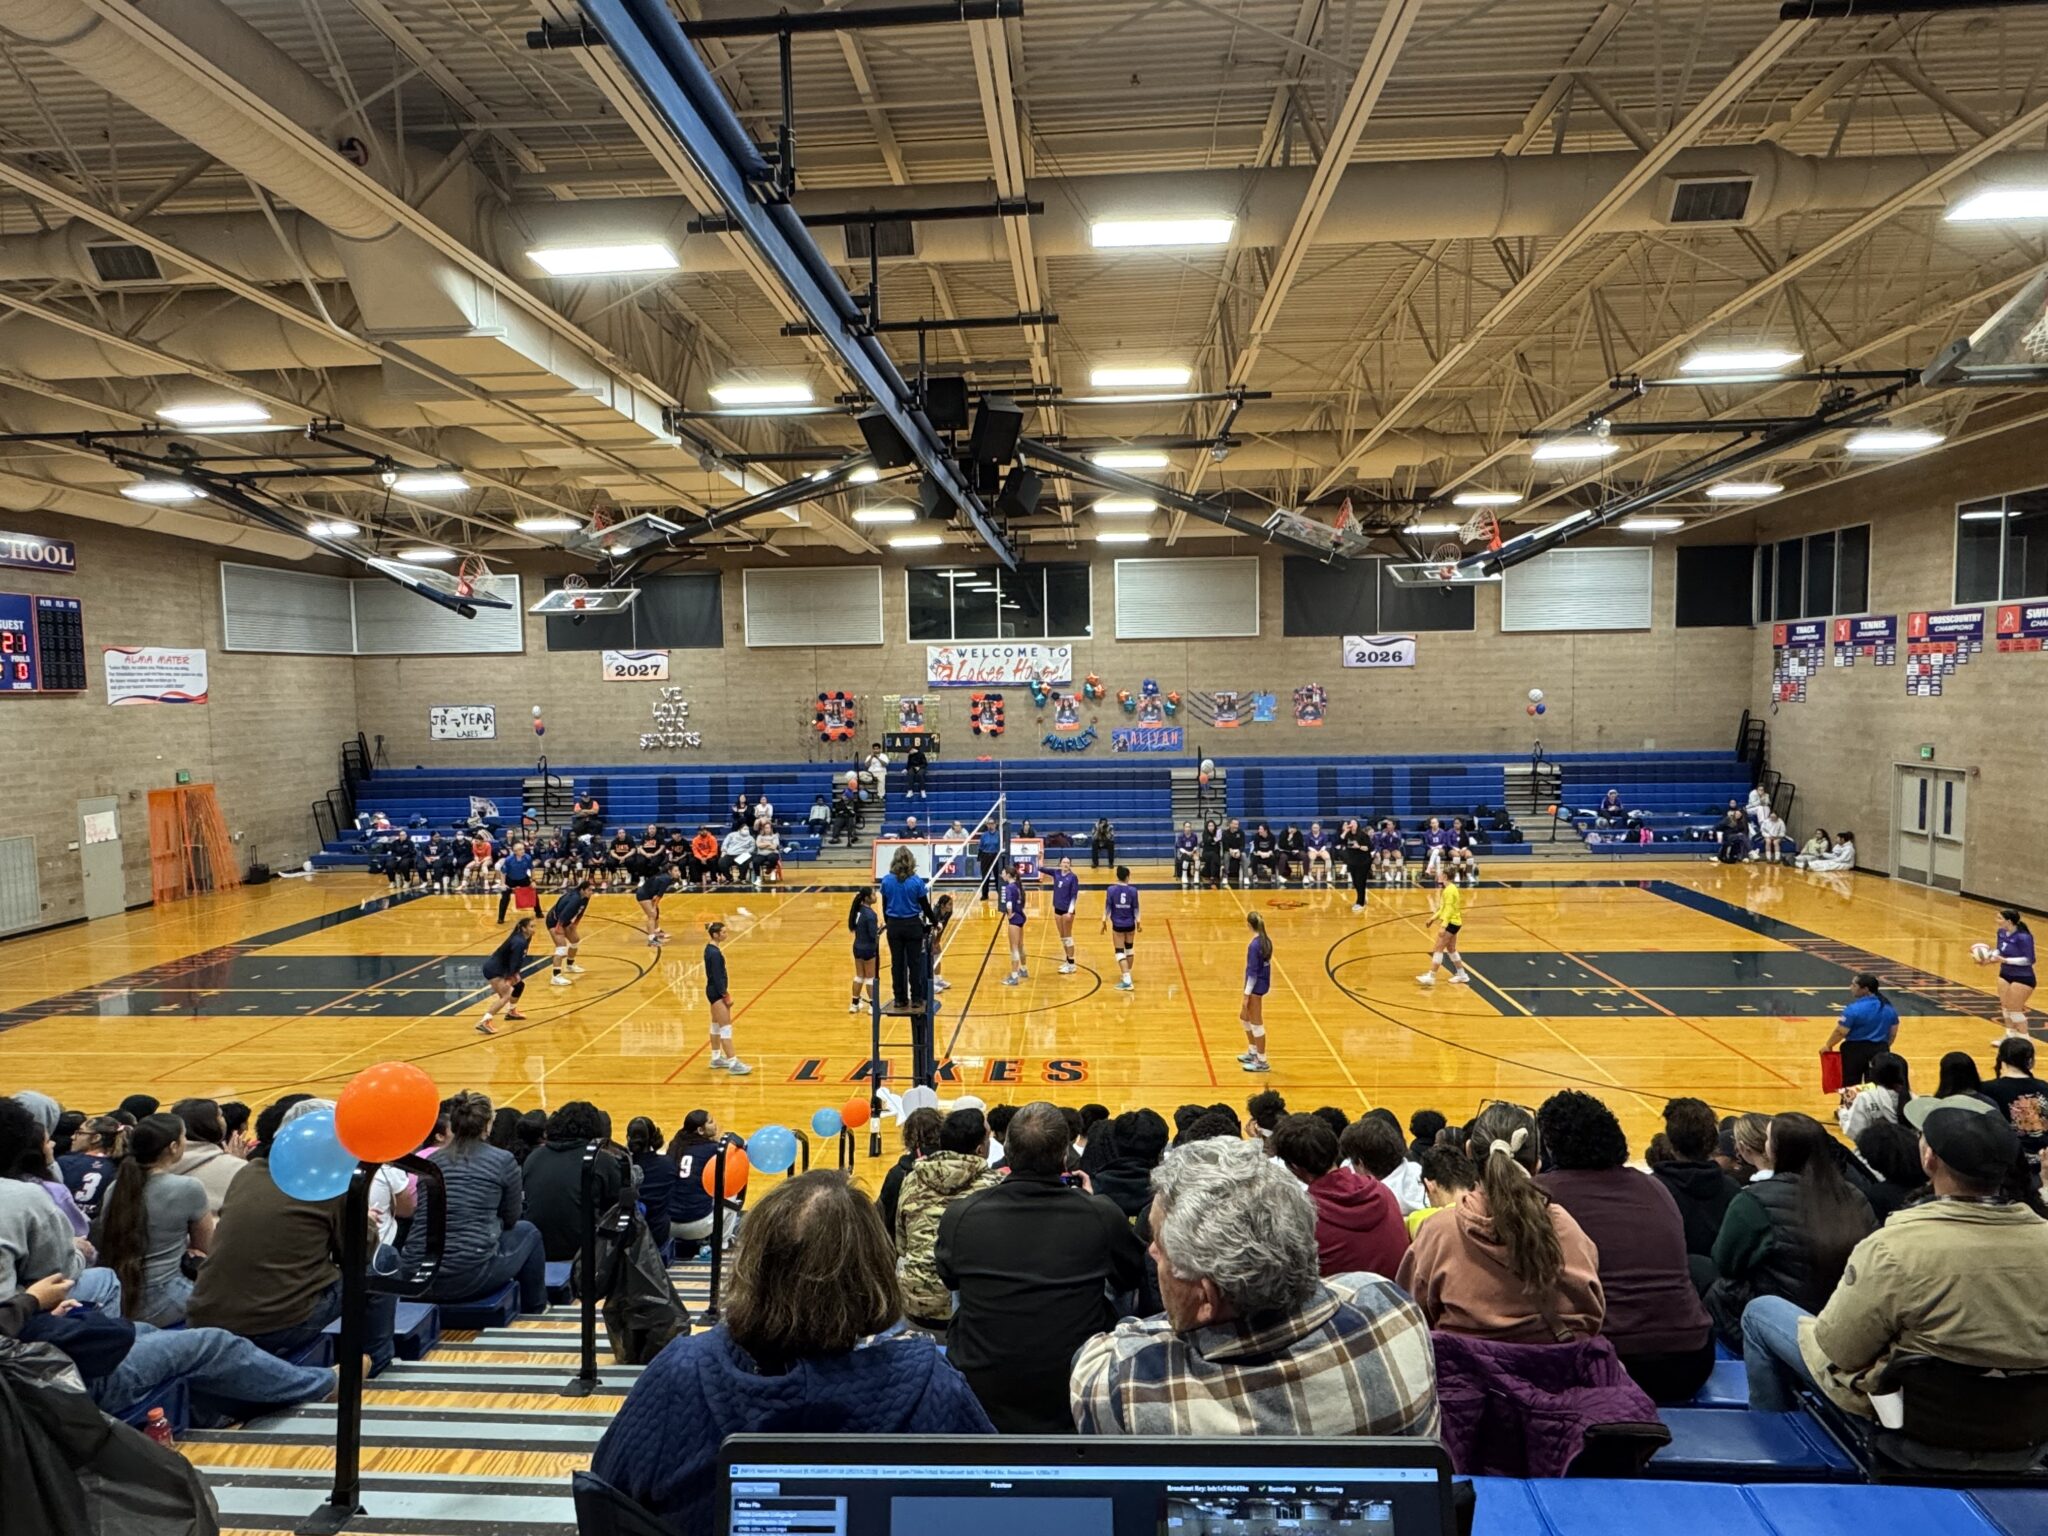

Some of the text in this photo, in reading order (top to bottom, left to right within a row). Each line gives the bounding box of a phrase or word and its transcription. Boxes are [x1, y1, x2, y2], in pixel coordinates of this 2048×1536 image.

[1860, 620, 1886, 630] TENNIS
[1934, 624, 1975, 632] CHAMPIONS
[1856, 629, 1890, 638] CHAMPIONS
[956, 647, 1068, 658] WELCOME TO
[1355, 651, 1402, 663] 2026
[124, 655, 190, 665] ALMA MATER
[615, 664, 661, 677] 2027
[461, 712, 493, 726] YEAR
[640, 732, 702, 750] SENIORS
[884, 737, 930, 748] GABBY
[1018, 863, 1033, 874] 21
[1120, 892, 1127, 905] 6
[787, 1056, 1089, 1084] LAKES
[679, 1155, 693, 1179] 9
[75, 1171, 103, 1202] 3
[1268, 1485, 1297, 1494] Recording
[1314, 1485, 1344, 1494] Streaming
